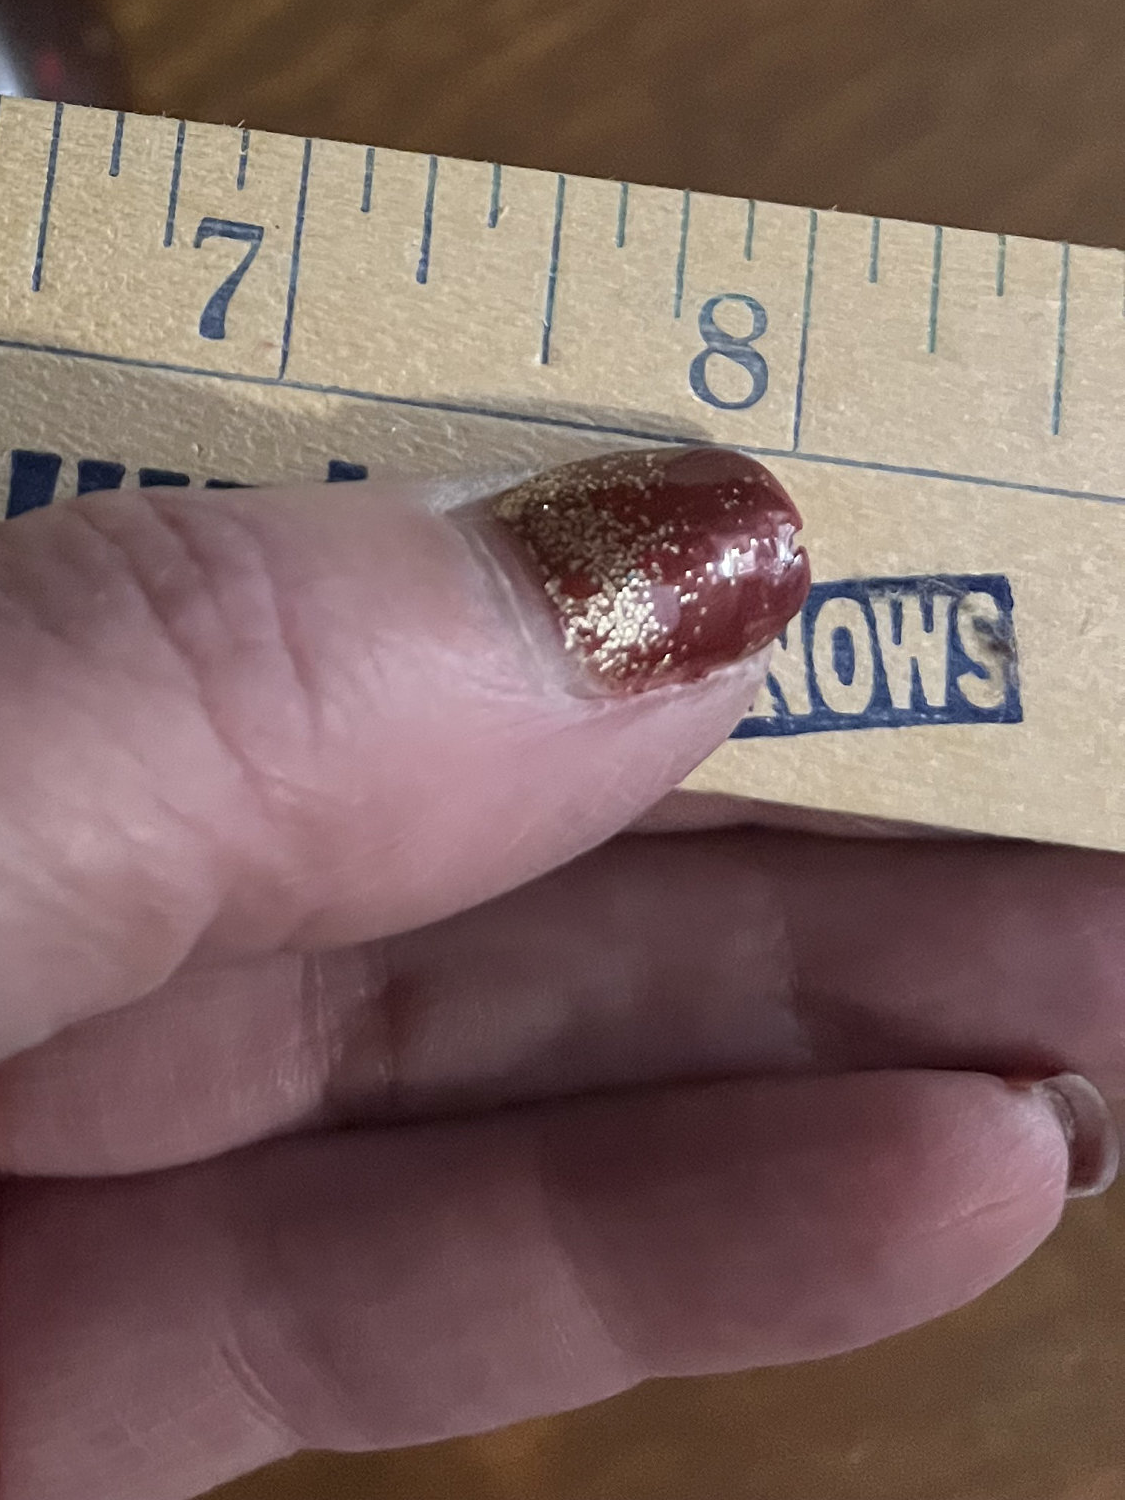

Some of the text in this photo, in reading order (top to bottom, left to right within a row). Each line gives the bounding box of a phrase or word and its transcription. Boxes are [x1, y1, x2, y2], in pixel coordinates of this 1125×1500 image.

[193, 216, 266, 341] 7
[688, 292, 770, 411] 8
[751, 590, 1011, 716] NOWS
